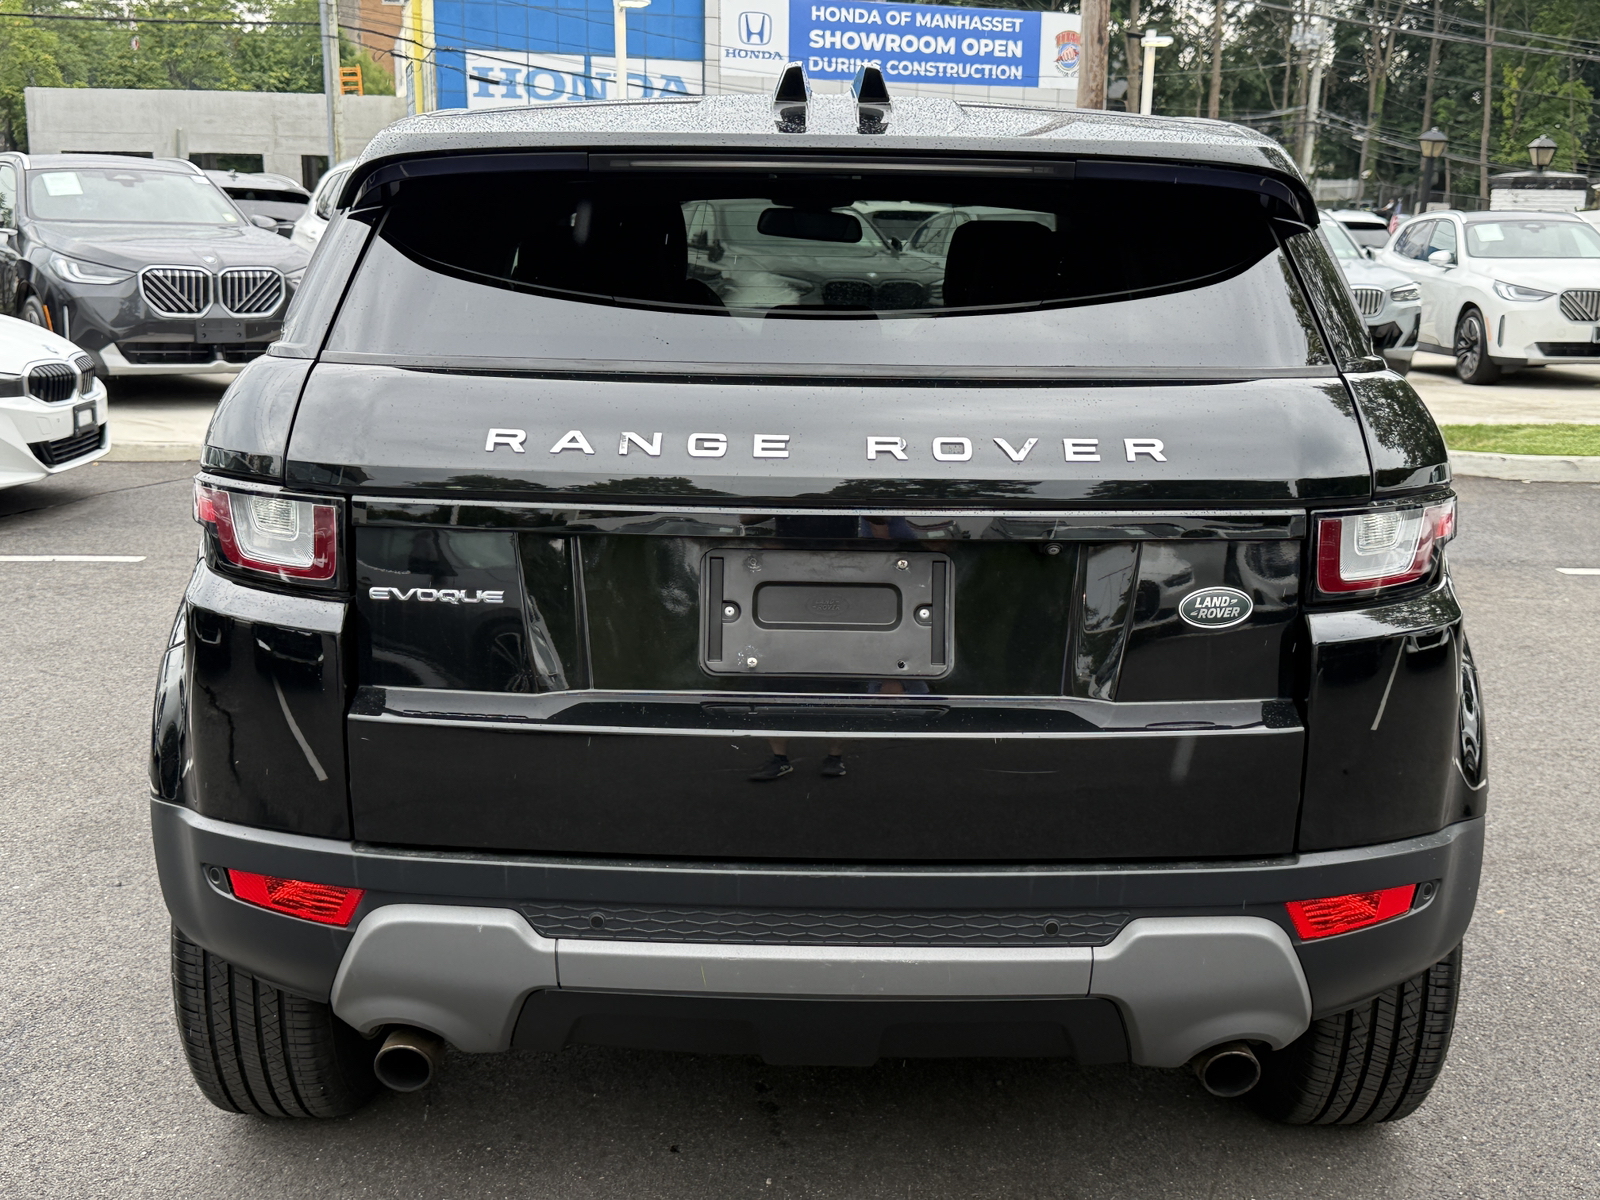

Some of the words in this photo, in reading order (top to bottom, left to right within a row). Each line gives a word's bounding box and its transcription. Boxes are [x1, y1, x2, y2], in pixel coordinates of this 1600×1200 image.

[811, 5, 882, 24] HONDA
[885, 10, 912, 26] OF
[915, 12, 1024, 33] MANHASSET
[808, 29, 956, 55] SHOWROOM
[961, 37, 1023, 58] OPEN
[724, 48, 783, 60] HONDA
[886, 59, 1023, 80] CONSTRUCTION
[485, 427, 790, 458] RANGE
[866, 435, 1168, 462] ROVER
[368, 586, 505, 605] EVOQUE
[1194, 596, 1231, 608] LAND
[1197, 606, 1241, 619] ROVER
